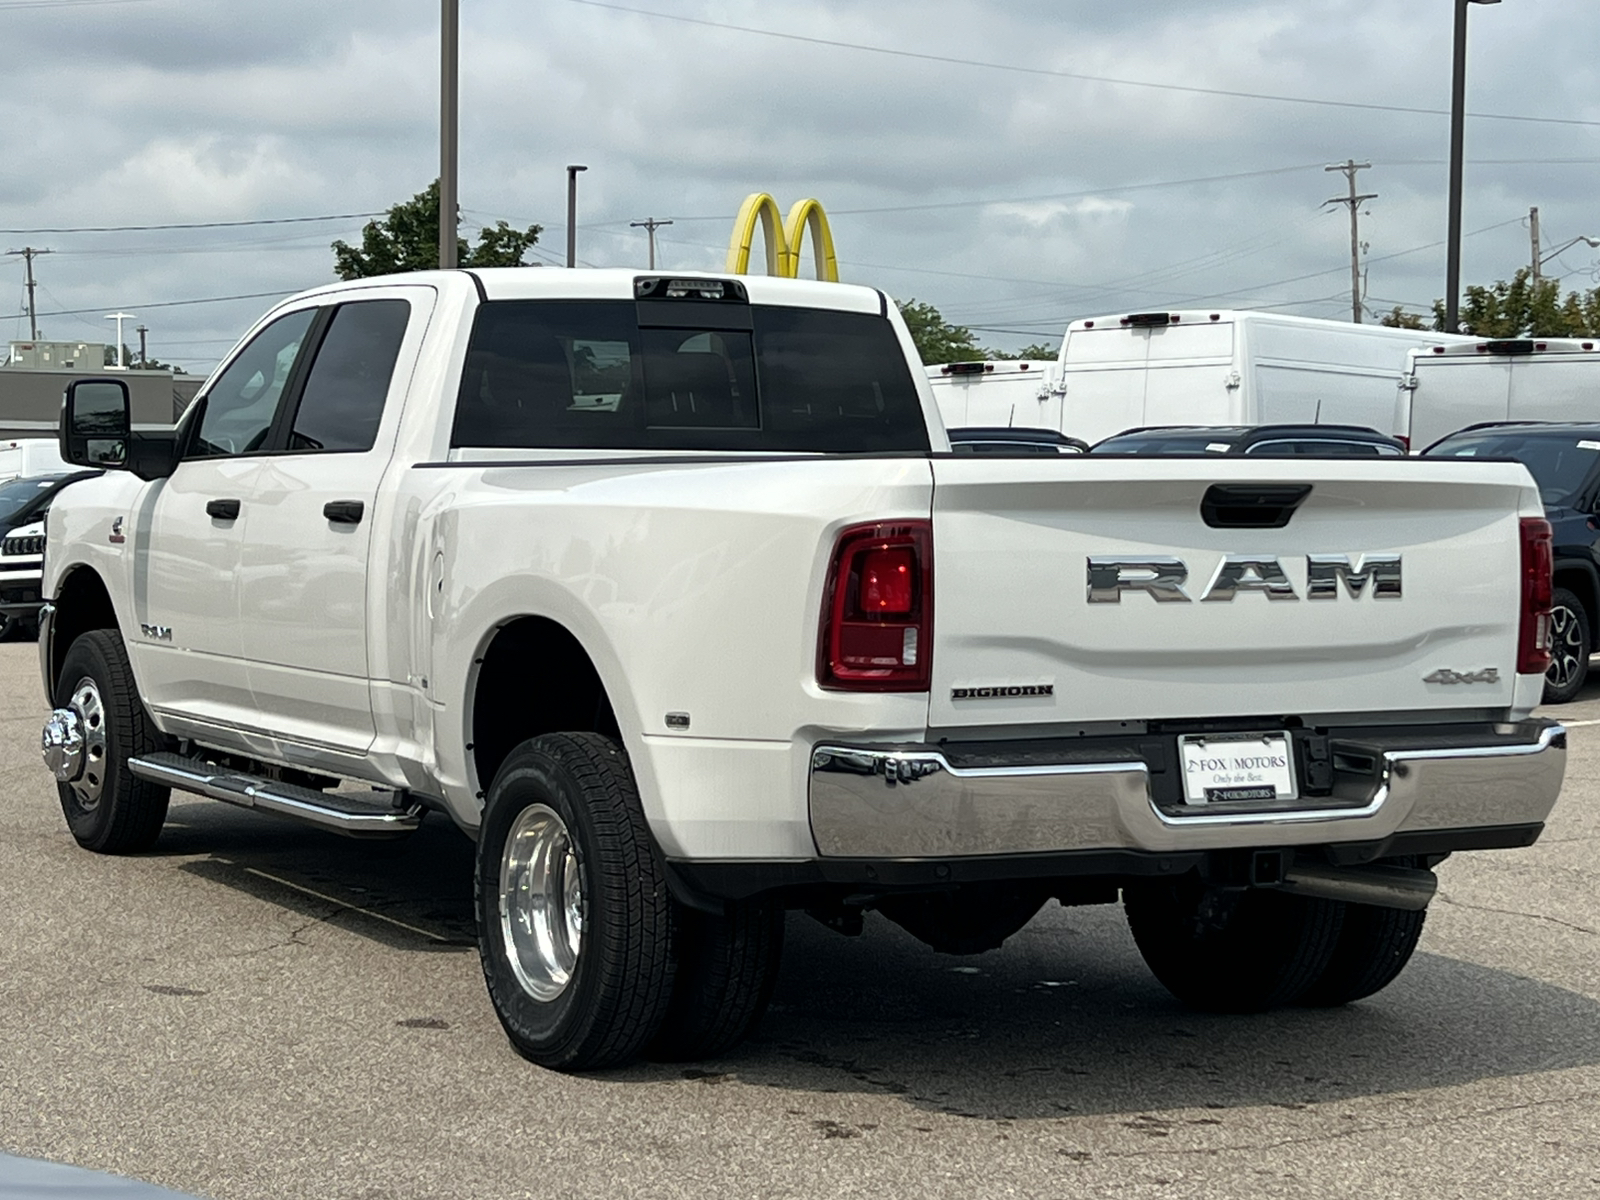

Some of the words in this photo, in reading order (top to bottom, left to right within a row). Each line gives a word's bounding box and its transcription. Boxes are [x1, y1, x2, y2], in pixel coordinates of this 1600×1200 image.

[1086, 553, 1403, 603] RAM
[1422, 667, 1500, 685] 4x4
[951, 685, 1054, 700] BIGHORN
[1200, 758, 1227, 771] FOX
[1234, 755, 1286, 770] MOTORS
[1213, 773, 1232, 784] Only
[1234, 772, 1245, 782] the
